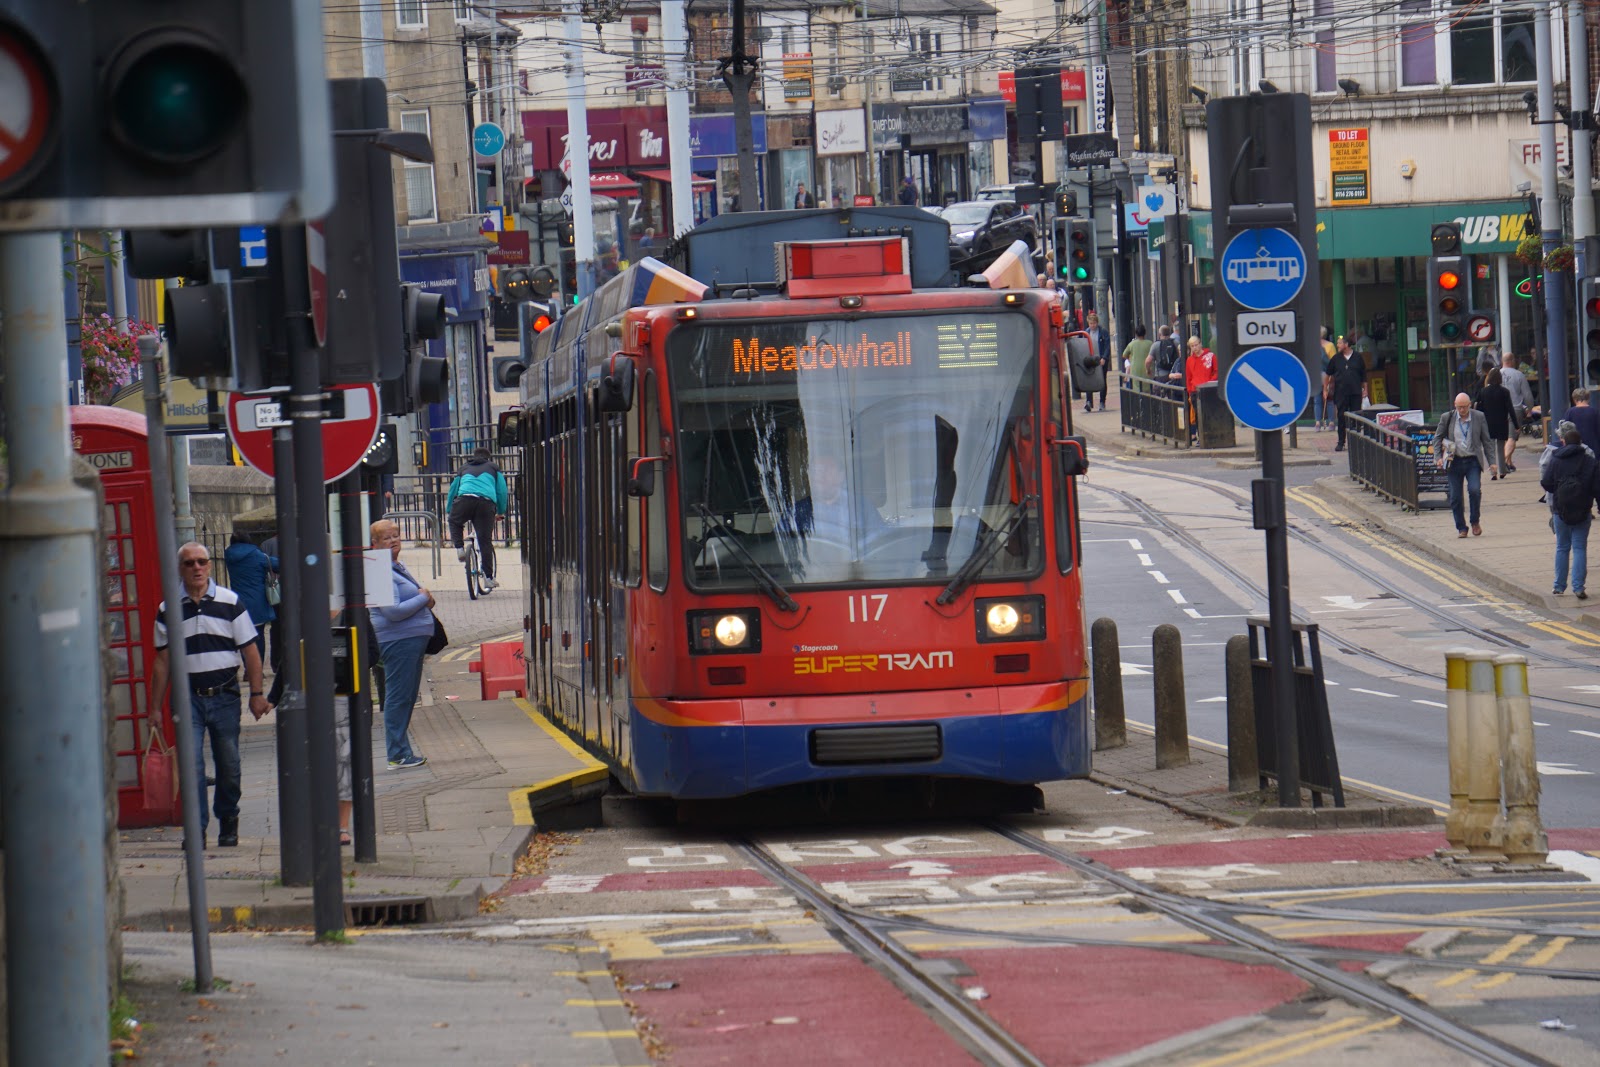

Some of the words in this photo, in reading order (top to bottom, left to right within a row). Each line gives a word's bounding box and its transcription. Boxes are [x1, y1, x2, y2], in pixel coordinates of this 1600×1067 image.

[1338, 131, 1346, 140] TO
[1347, 130, 1358, 140] LET
[1523, 142, 1565, 165] FRE
[1453, 213, 1534, 243] UBW
[1246, 321, 1287, 337] Only
[733, 331, 912, 374] Meadowhall
[260, 407, 271, 415] No
[848, 594, 888, 623] 117
[801, 644, 838, 653] Stagecoach
[794, 651, 954, 675] SUPERTRAM
